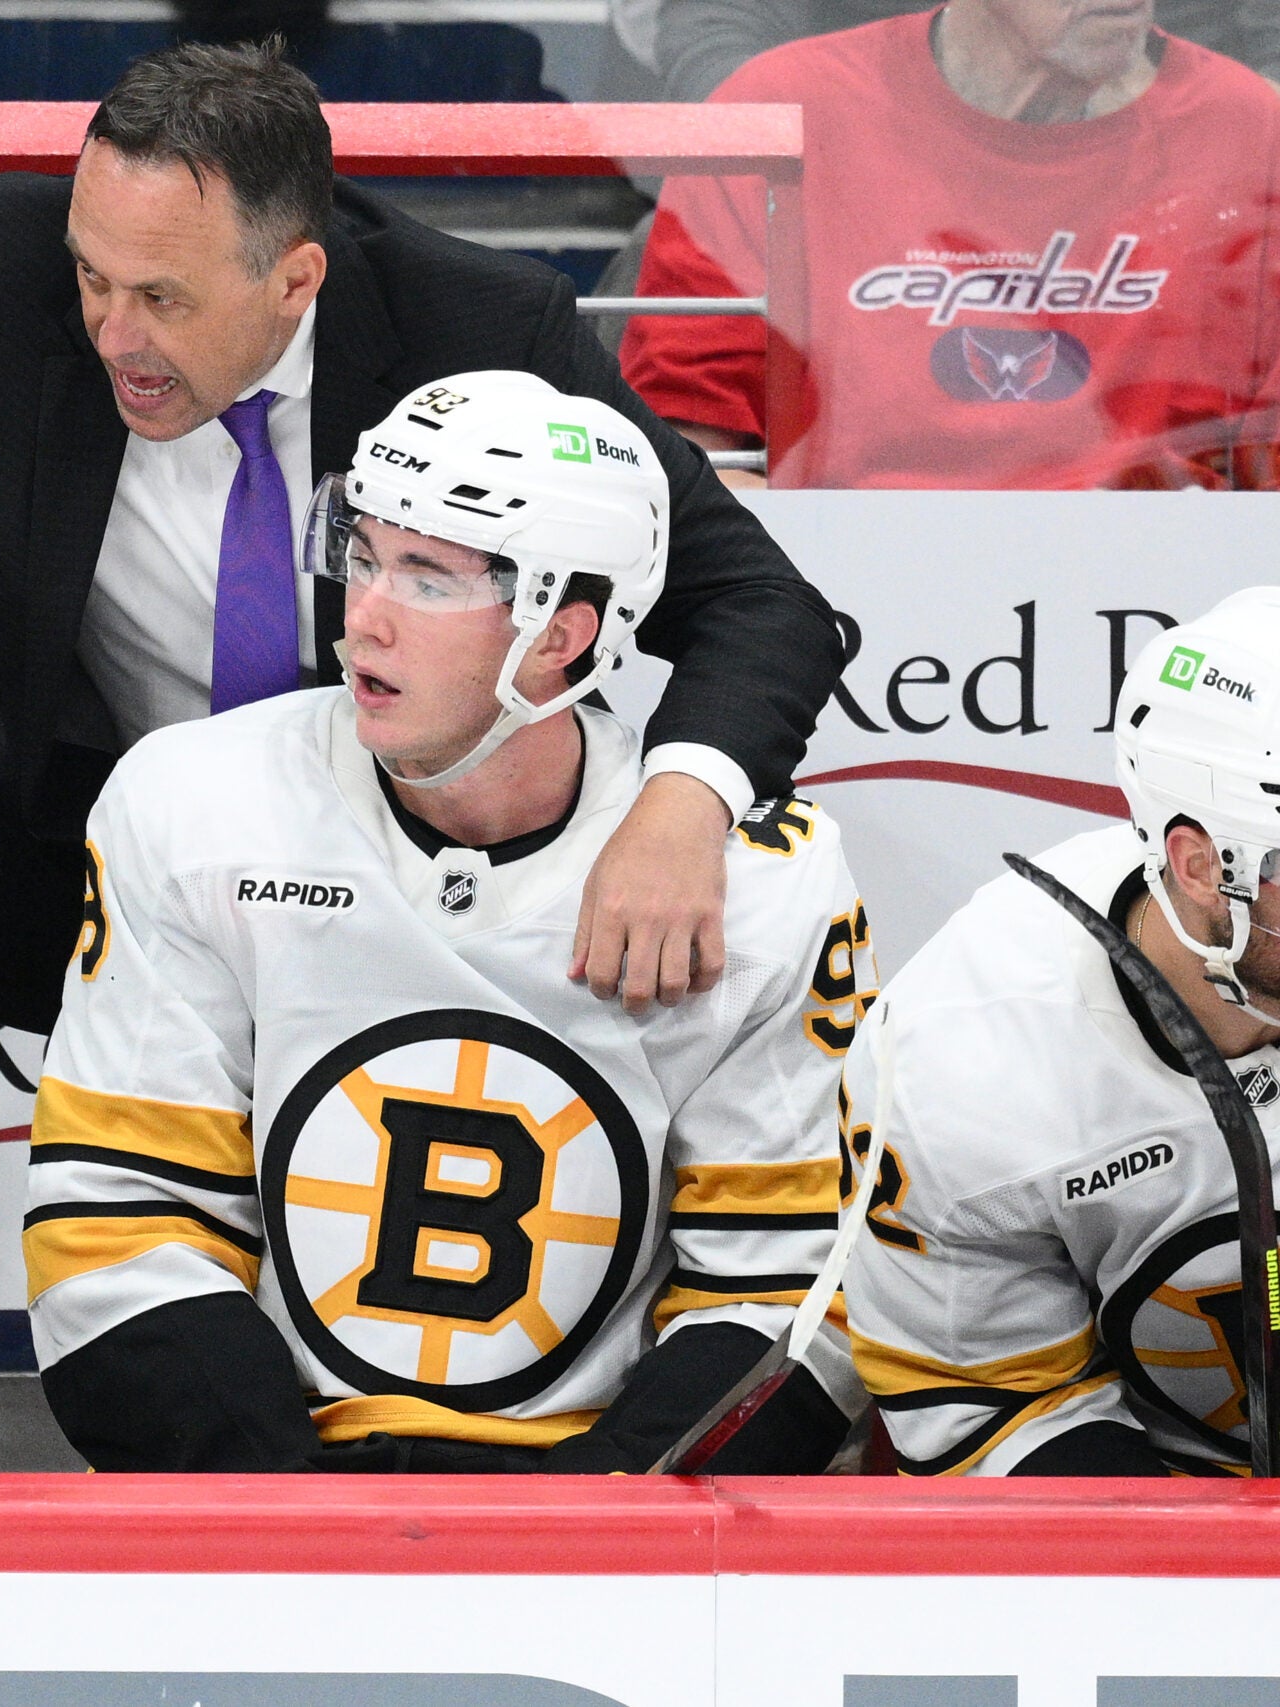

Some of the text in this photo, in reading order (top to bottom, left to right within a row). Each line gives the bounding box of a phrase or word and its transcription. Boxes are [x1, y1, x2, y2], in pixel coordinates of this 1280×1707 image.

[848, 230, 1168, 327] capitals
[369, 442, 432, 474] CCM
[595, 437, 641, 468] Bank
[1202, 666, 1258, 703] Bank
[237, 878, 354, 909] RAPID7
[444, 880, 472, 906] NHL
[1247, 1064, 1276, 1101] NHL
[1065, 1142, 1174, 1200] RAPID7
[356, 1096, 546, 1323] B
[1266, 1248, 1280, 1332] WARRIOR
